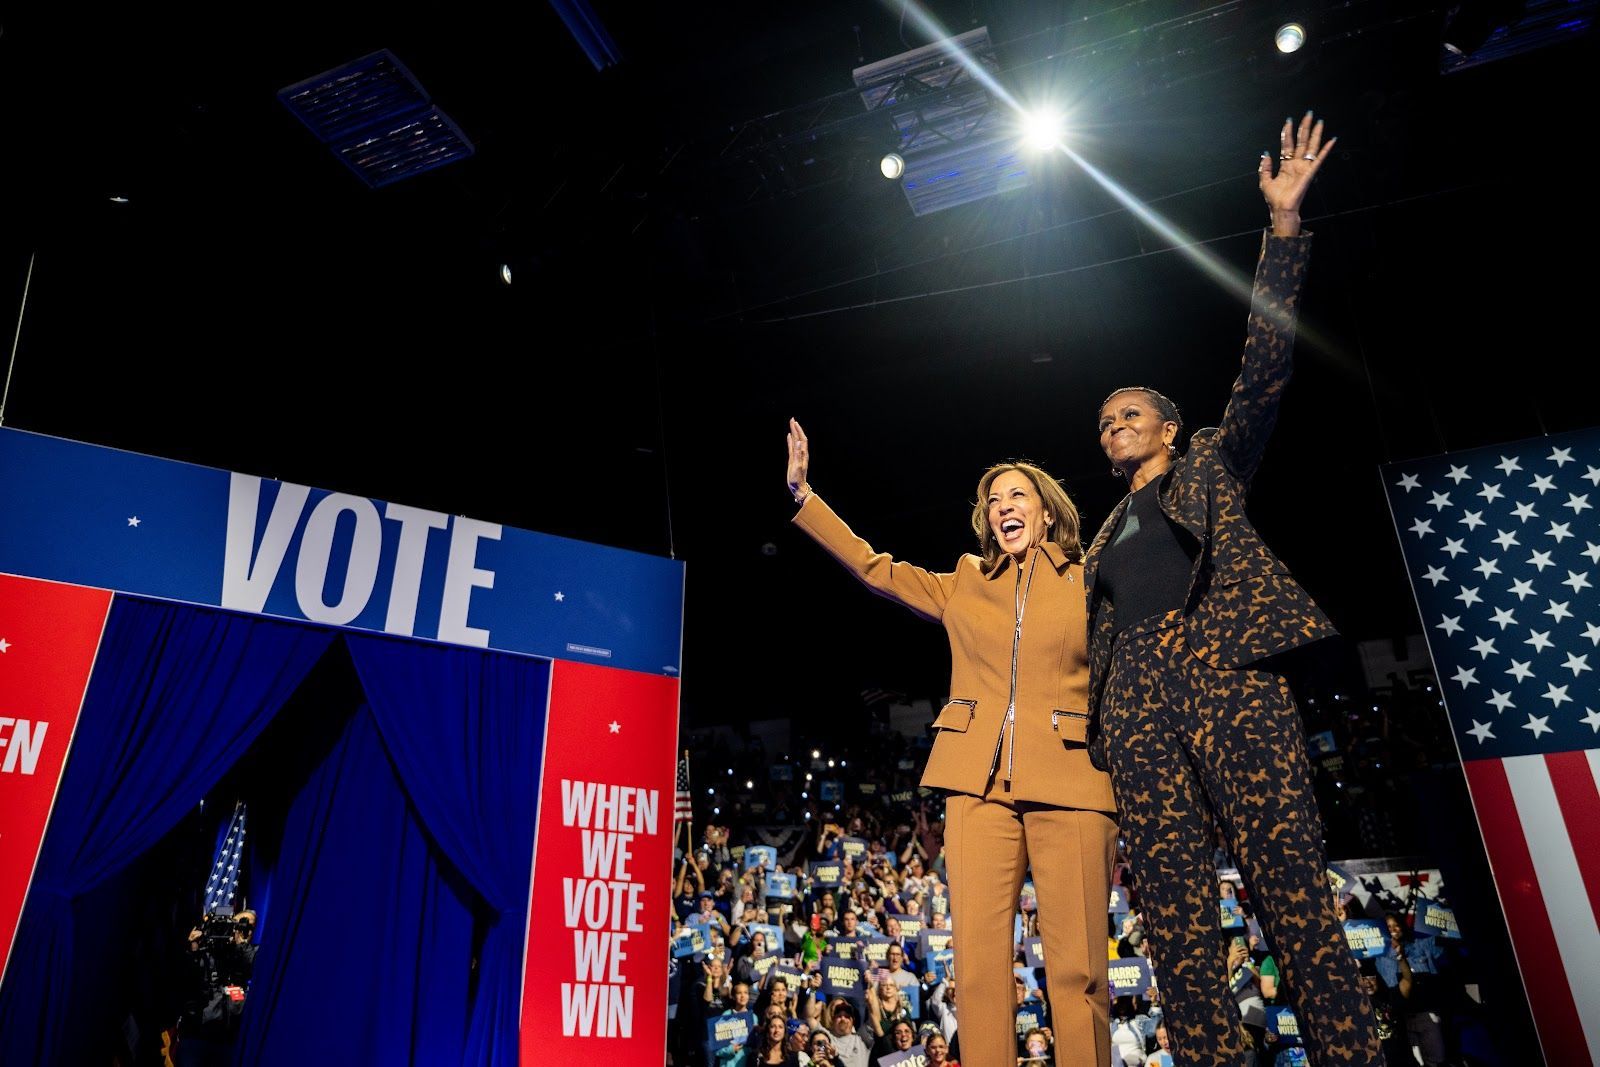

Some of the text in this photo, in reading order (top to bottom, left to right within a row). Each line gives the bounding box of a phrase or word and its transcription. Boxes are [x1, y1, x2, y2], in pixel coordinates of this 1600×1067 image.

[221, 471, 502, 648] VOTE
[561, 779, 659, 835] WHEN
[581, 829, 634, 881] WE
[816, 866, 840, 877] HARRIS
[563, 877, 645, 932] VOTE
[573, 930, 628, 983] WE
[827, 965, 860, 982] HARRIS
[1107, 966, 1142, 981] HARRIS
[831, 978, 855, 989] WALZ
[1114, 978, 1139, 989] WALZ
[561, 982, 634, 1039] WIN
